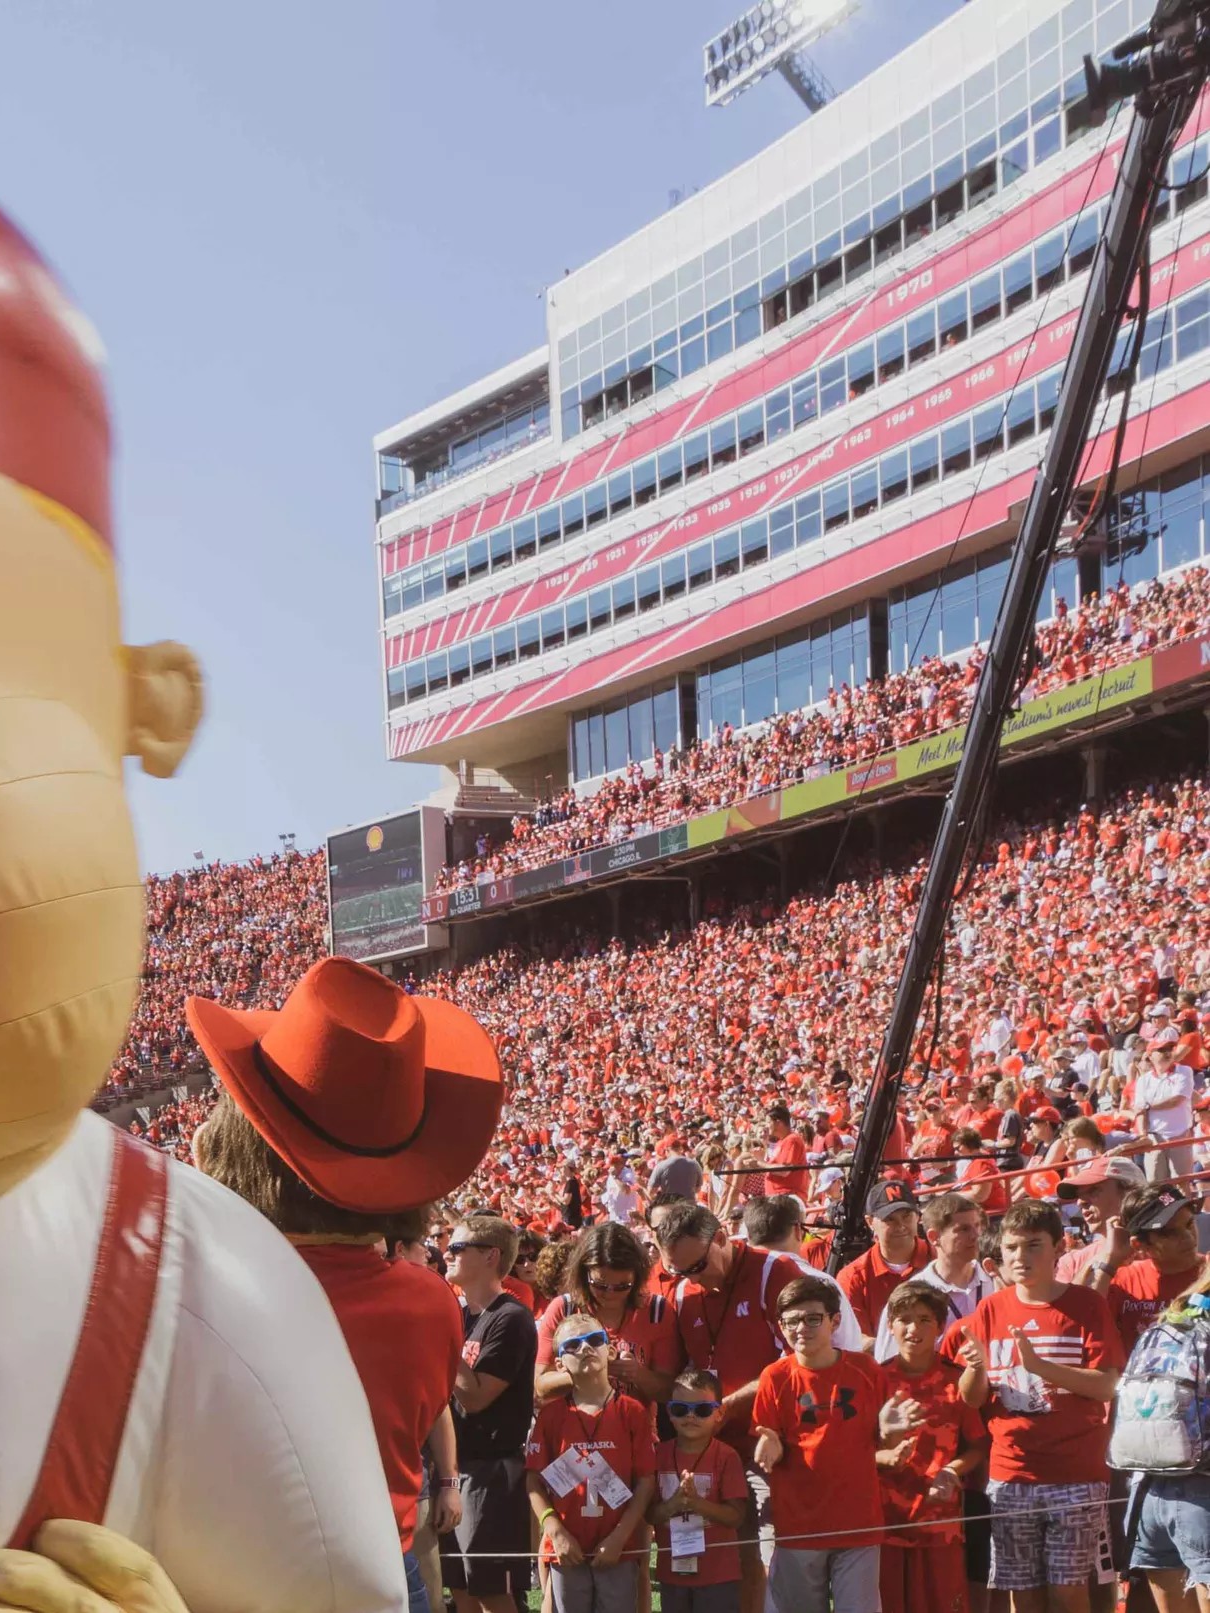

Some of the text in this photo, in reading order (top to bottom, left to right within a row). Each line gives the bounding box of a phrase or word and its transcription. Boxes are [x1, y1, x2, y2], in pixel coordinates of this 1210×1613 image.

[886, 270, 933, 307] 1970
[1056, 688, 1095, 716] newest
[885, 1185, 902, 1202] N
[736, 1301, 750, 1317] N
